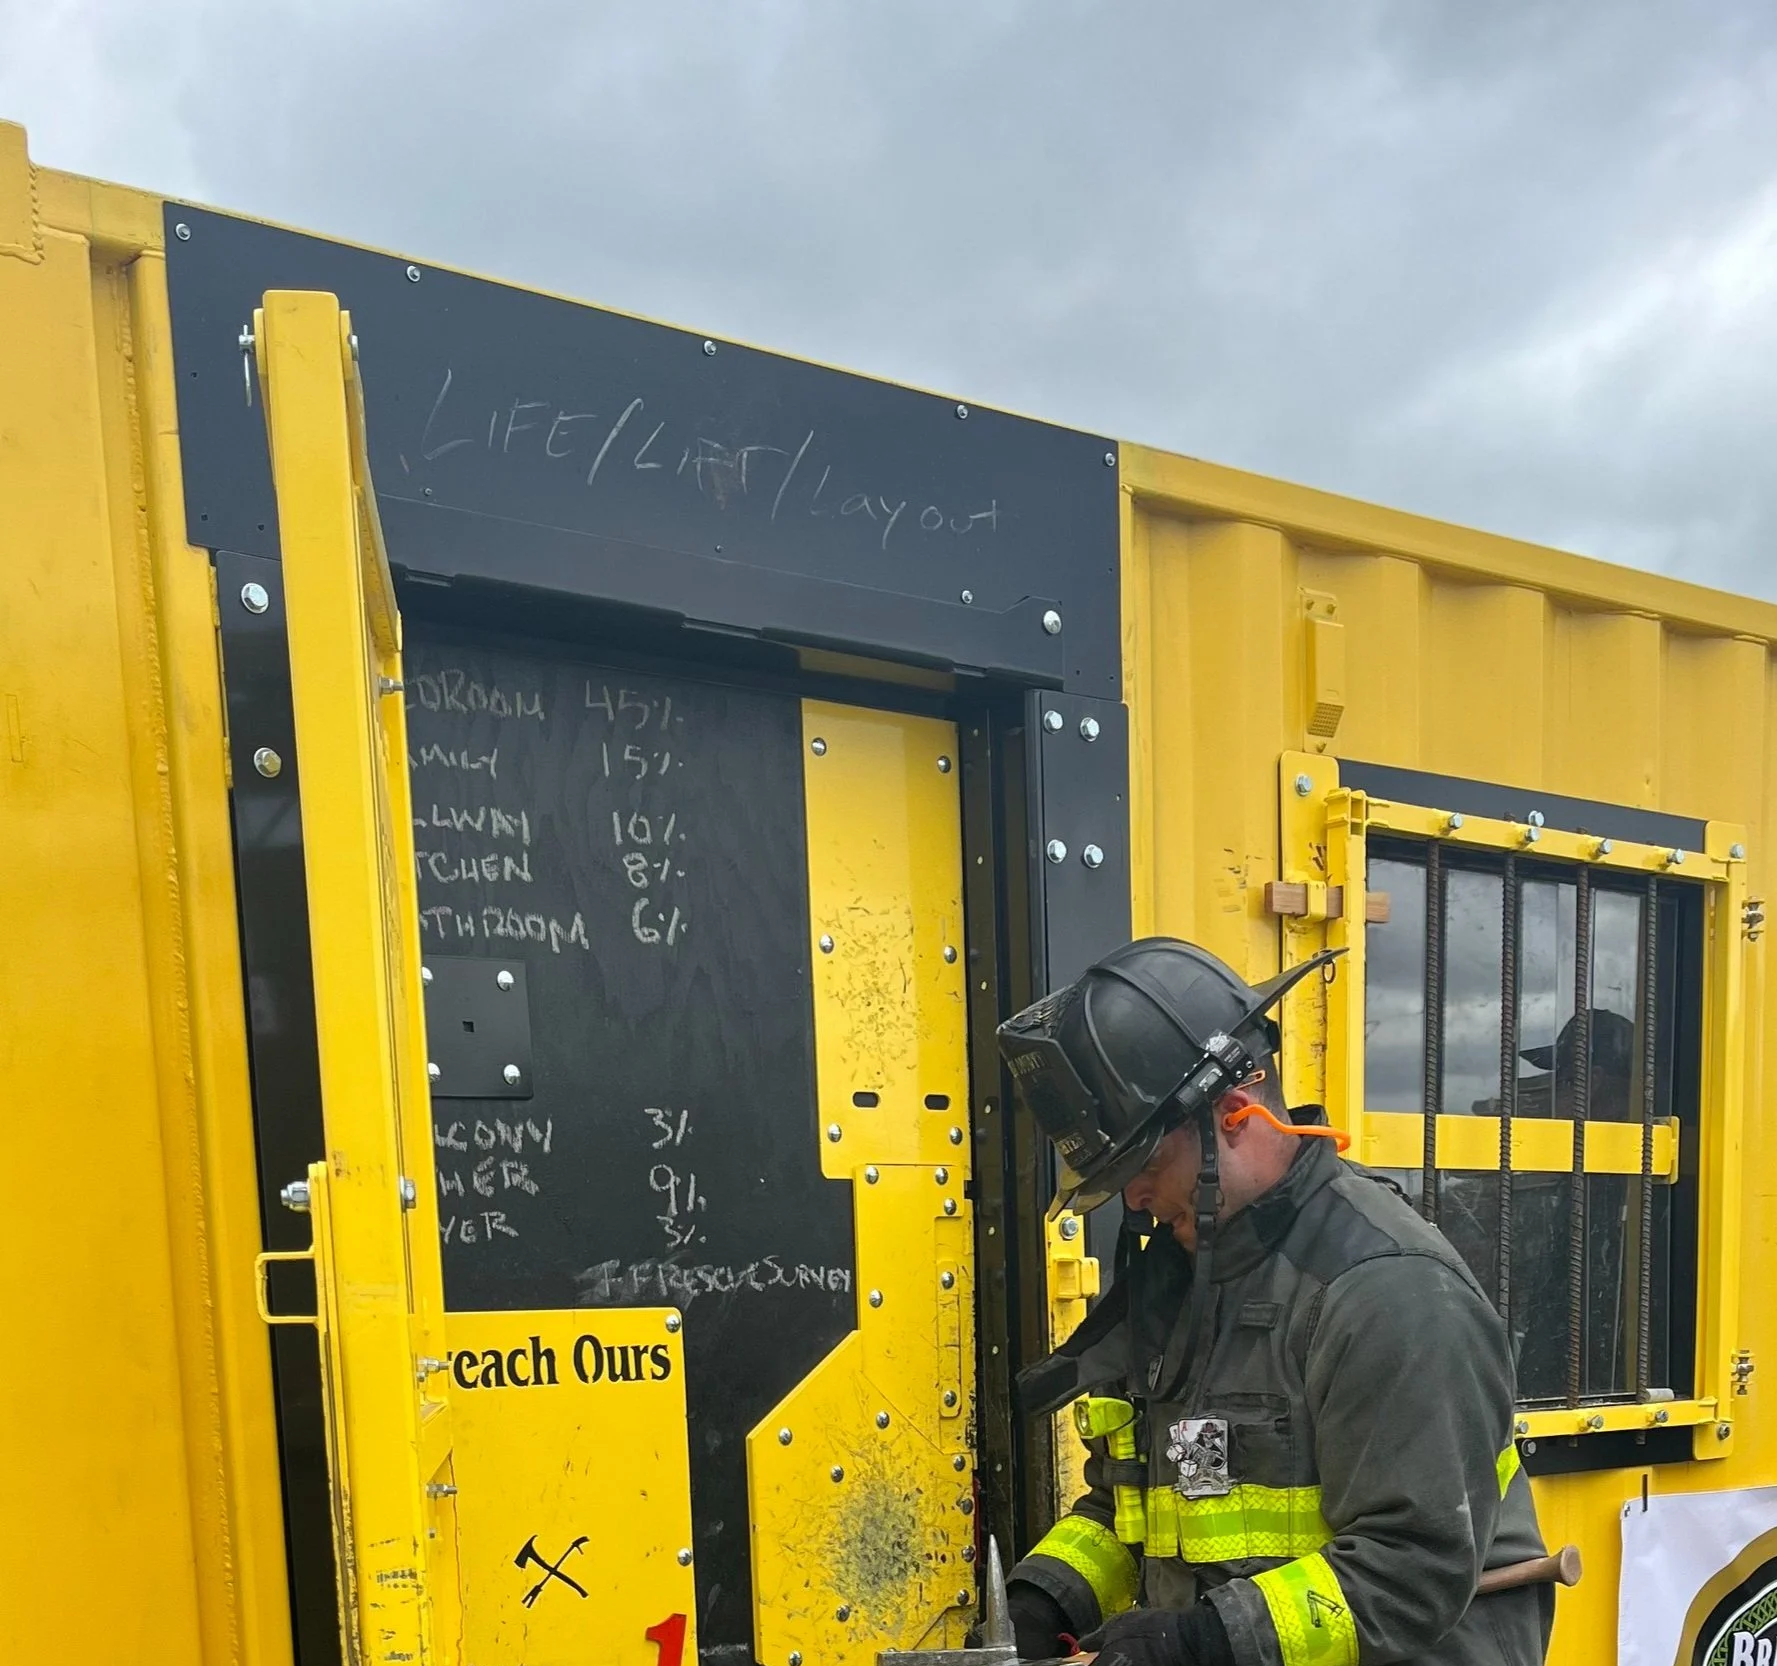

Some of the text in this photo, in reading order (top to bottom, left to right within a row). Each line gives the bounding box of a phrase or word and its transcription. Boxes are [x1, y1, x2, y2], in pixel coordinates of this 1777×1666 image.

[405, 668, 684, 730] DROOM 45%
[602, 742, 684, 780] 15%
[612, 811, 686, 846] 10%
[414, 849, 685, 889] TCHEN 8%
[631, 897, 688, 947] 6%
[434, 1107, 694, 1154] LCONY 3%
[435, 1155, 707, 1216] HER 9%
[439, 1211, 707, 1249] YER 3%
[447, 1333, 673, 1390] each Ours
